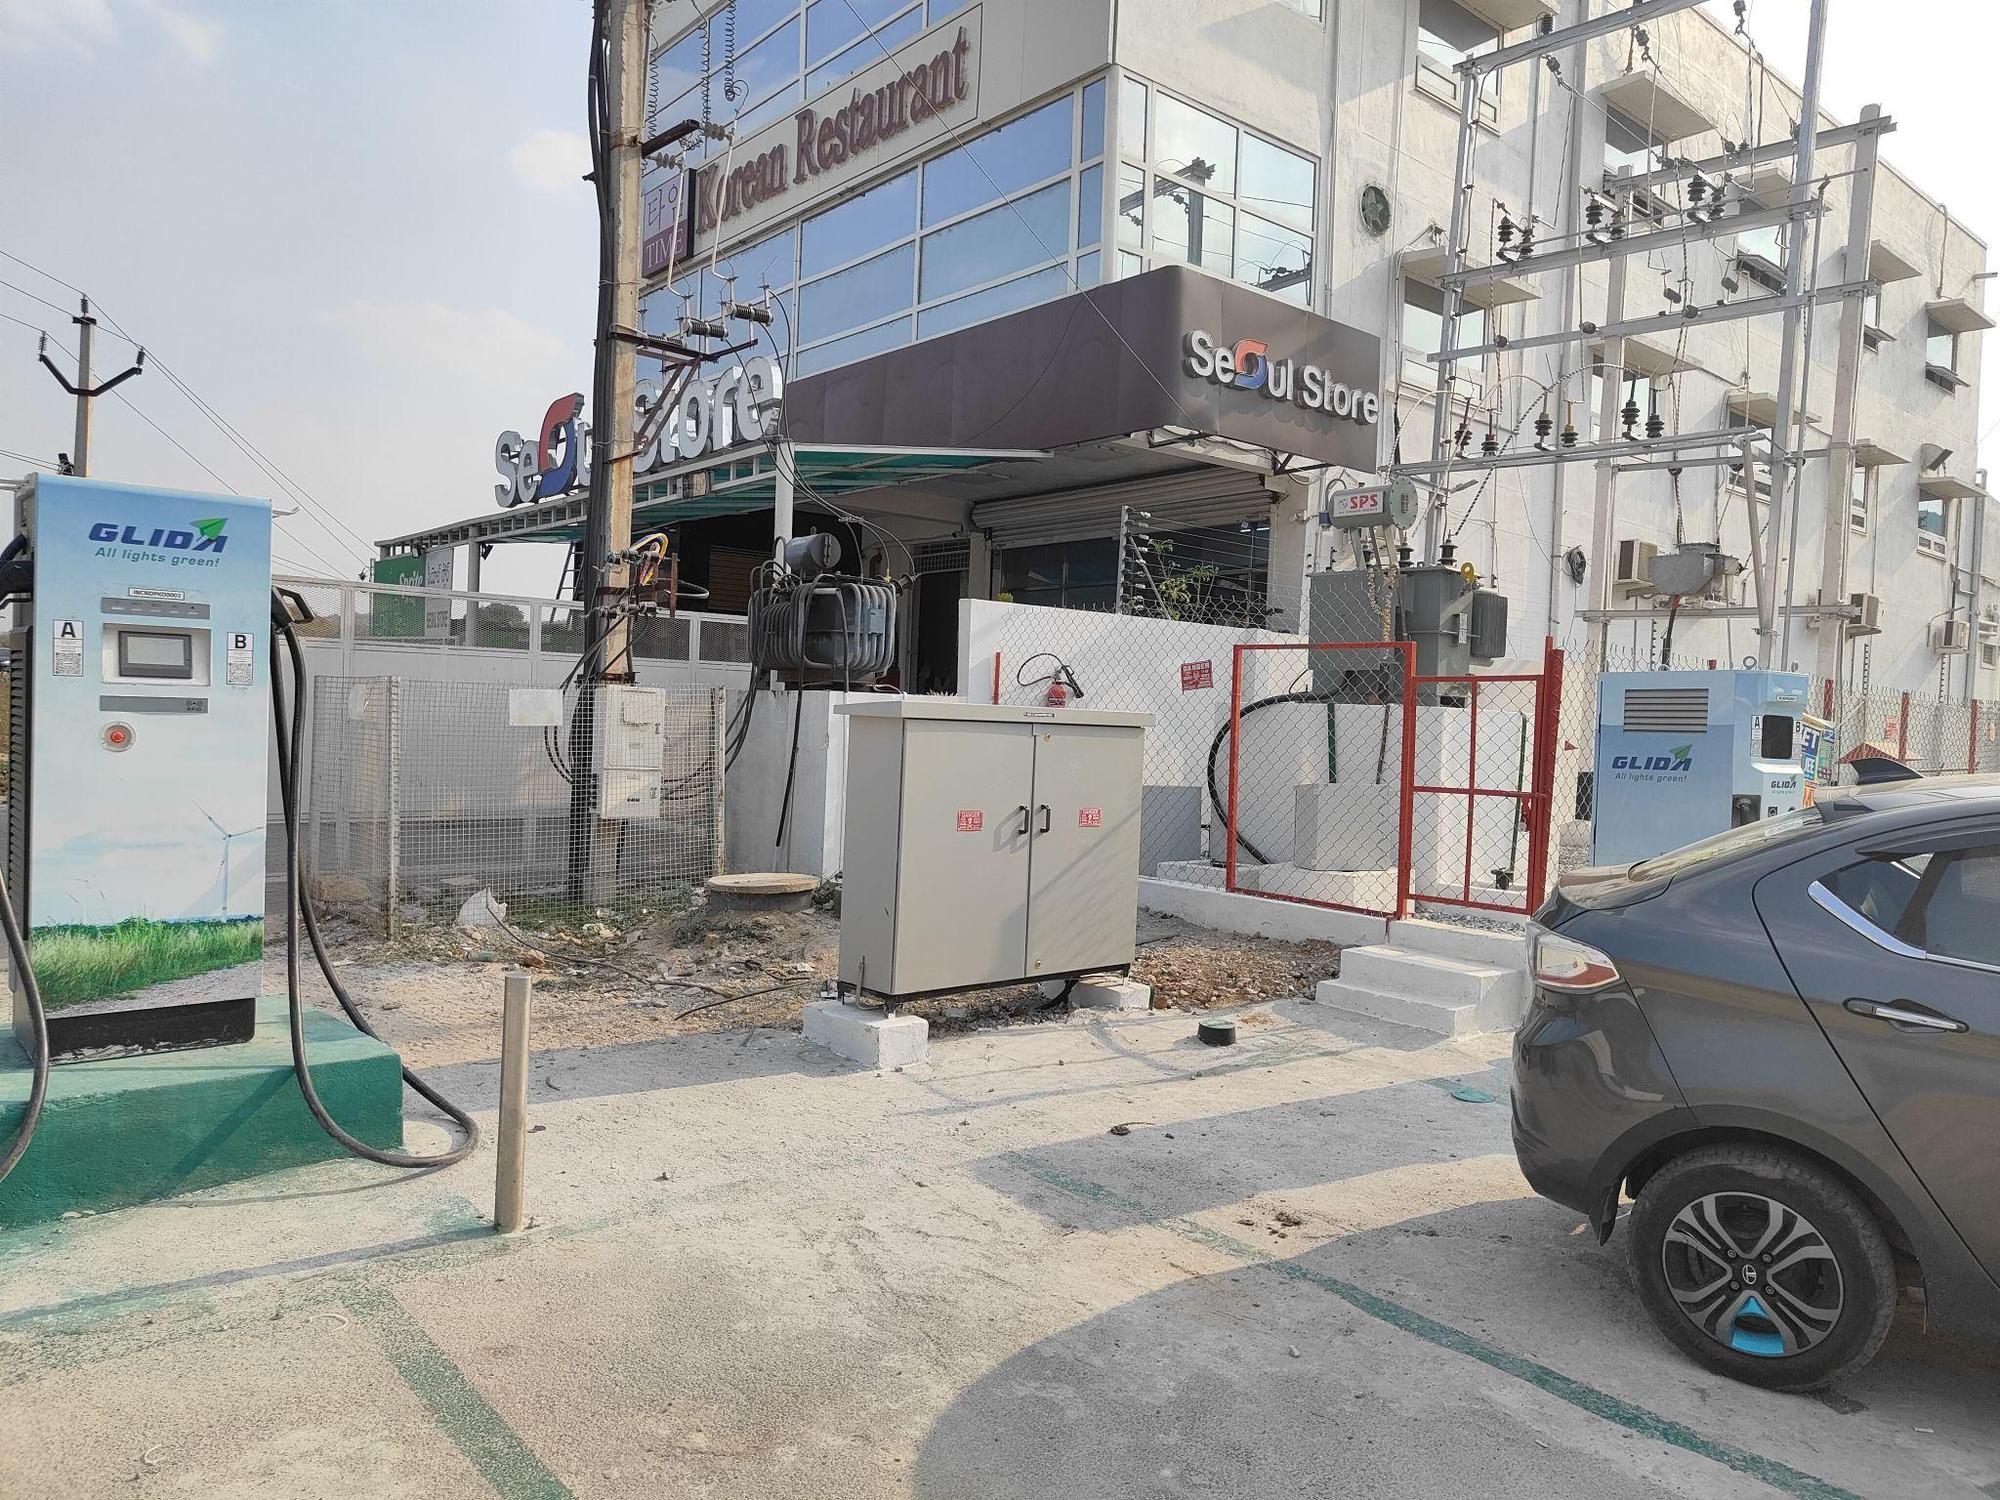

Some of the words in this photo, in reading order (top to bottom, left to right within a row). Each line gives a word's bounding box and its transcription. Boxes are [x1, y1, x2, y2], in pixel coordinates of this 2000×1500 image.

[696, 143, 788, 234] Korean
[793, 26, 970, 184] Restaurant
[646, 227, 684, 268] TIME
[1187, 329, 1295, 400] Seoul
[1302, 364, 1379, 425] Store
[1349, 493, 1378, 510] SPS
[88, 522, 229, 554] GLIDA
[94, 546, 118, 559] All
[121, 548, 167, 563] lights
[170, 555, 221, 568] green!
[61, 621, 76, 638] A
[235, 634, 247, 649] B
[1753, 716, 1760, 729] A
[1795, 721, 1801, 733] B
[1611, 755, 1693, 772] GLIDA
[1615, 772, 1626, 781] All
[1628, 772, 1655, 782] lights
[1657, 774, 1687, 783] green!
[1771, 780, 1797, 789] GLIDA
